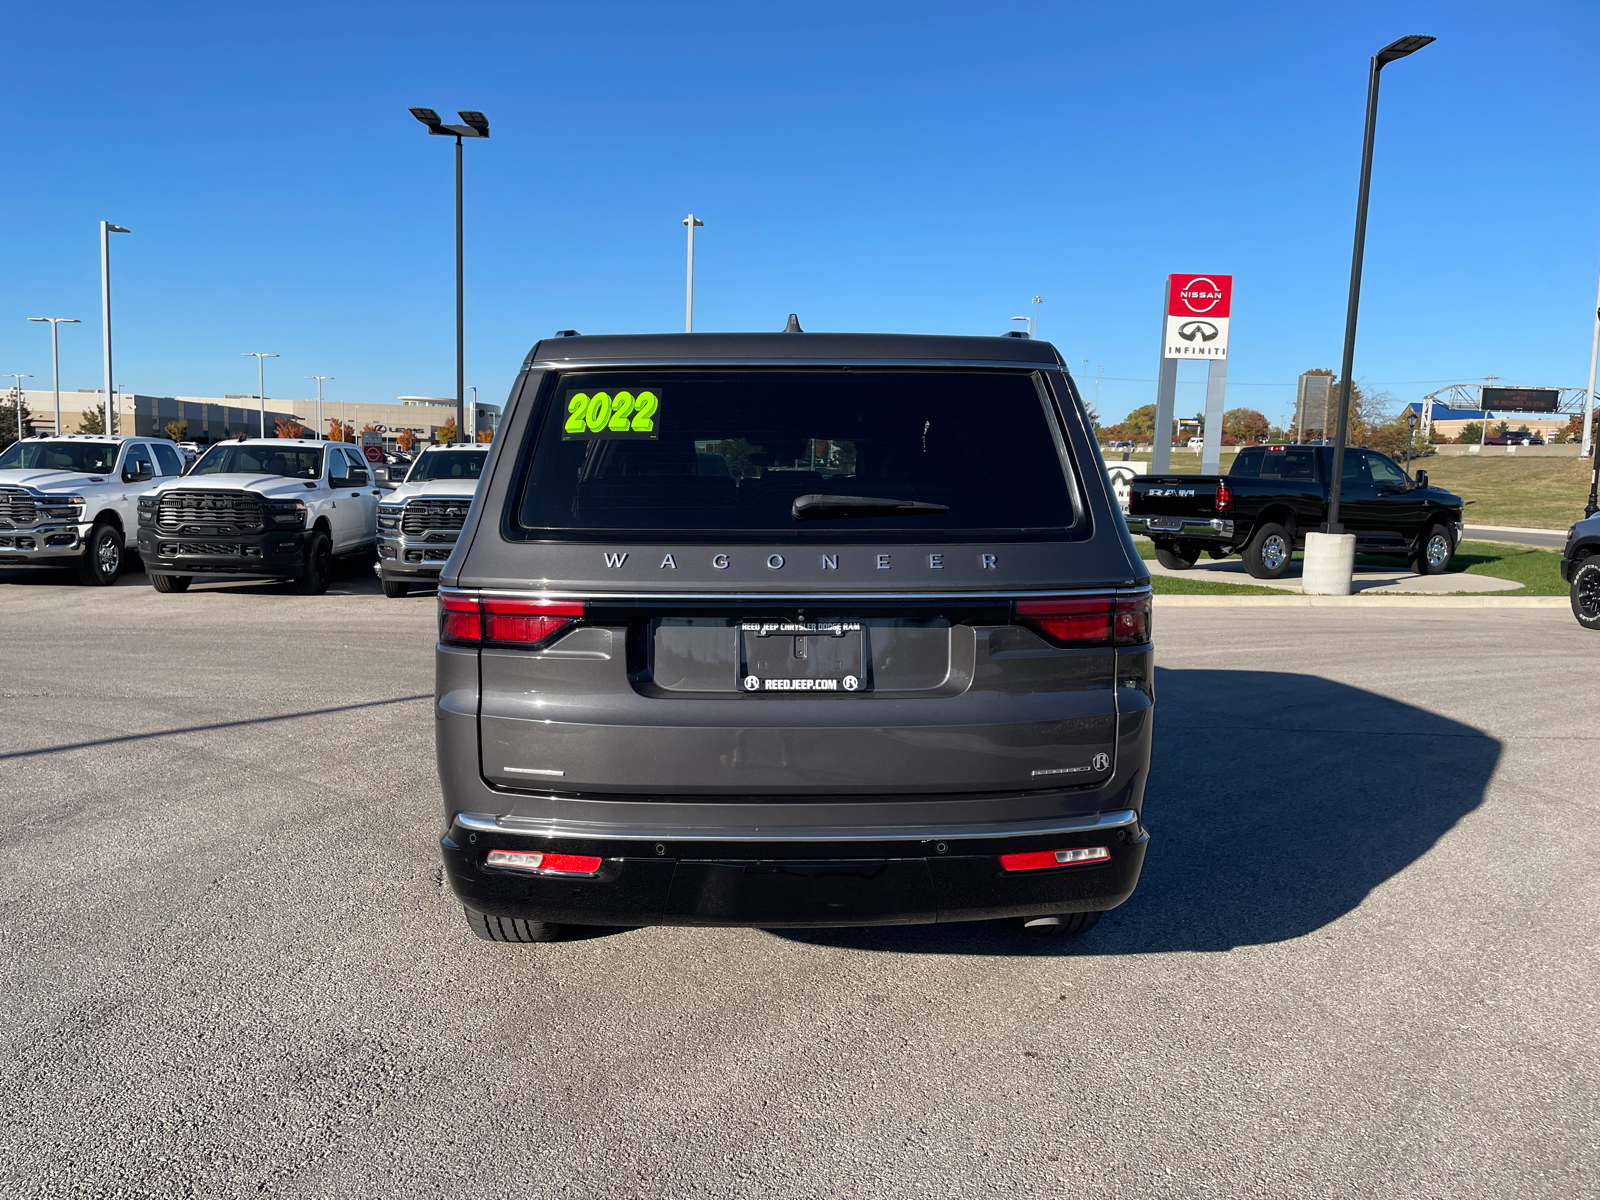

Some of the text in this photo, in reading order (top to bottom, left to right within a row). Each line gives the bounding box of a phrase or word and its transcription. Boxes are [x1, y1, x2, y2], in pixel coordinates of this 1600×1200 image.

[1180, 291, 1222, 299] NISSAN
[1168, 346, 1226, 355] INFINITI
[565, 391, 659, 433] 2022
[1148, 488, 1195, 498] RAM
[182, 500, 232, 509] RAM
[603, 552, 998, 571] WAGONEER
[742, 623, 860, 631] REED JEEP CHRYSLER DODGE RAM
[765, 679, 837, 690] REEDJEEP.COM
